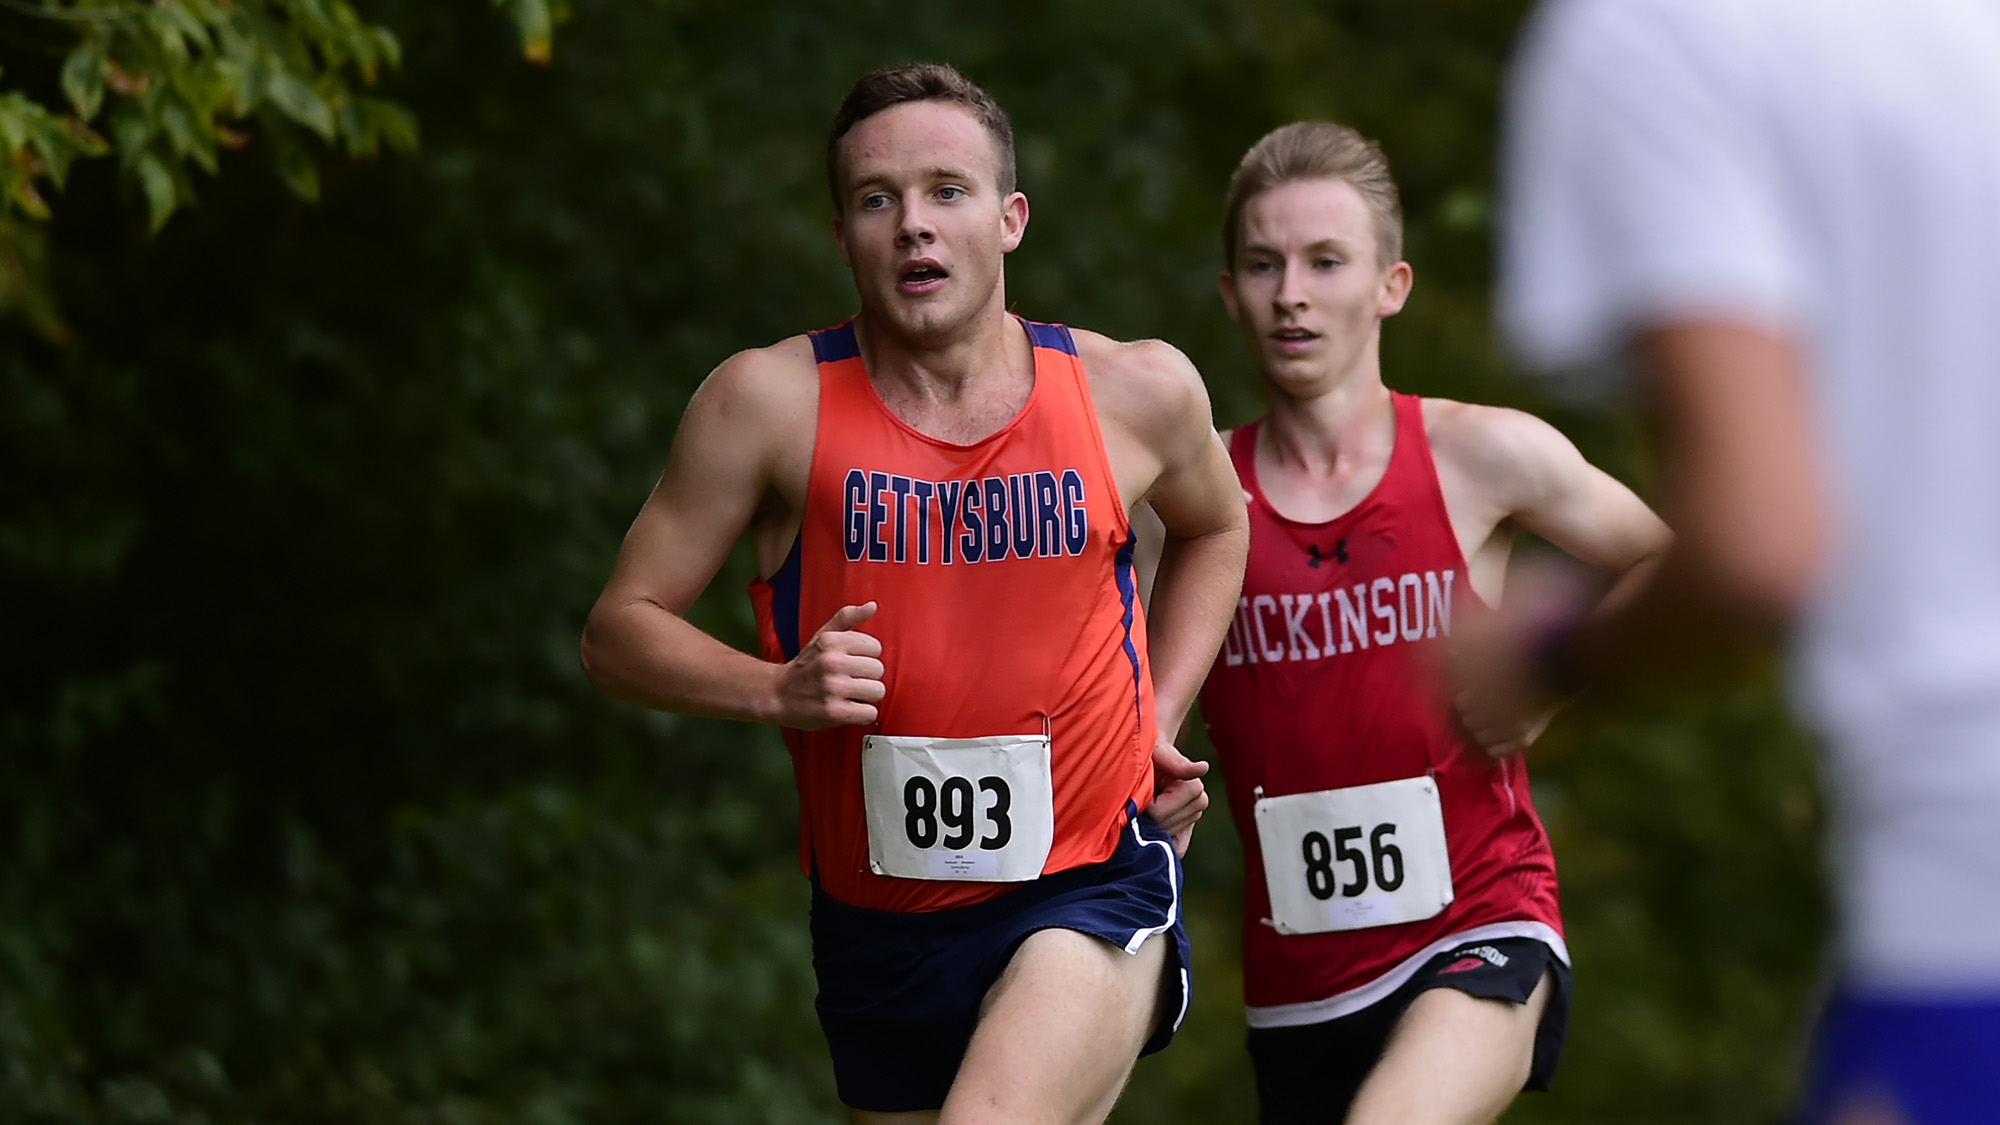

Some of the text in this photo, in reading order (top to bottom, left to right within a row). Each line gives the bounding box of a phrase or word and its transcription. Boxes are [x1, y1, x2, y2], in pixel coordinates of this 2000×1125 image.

[843, 469, 1087, 565] GETTYSBURG
[904, 776, 1012, 850] 893
[1302, 822, 1404, 900] 856
